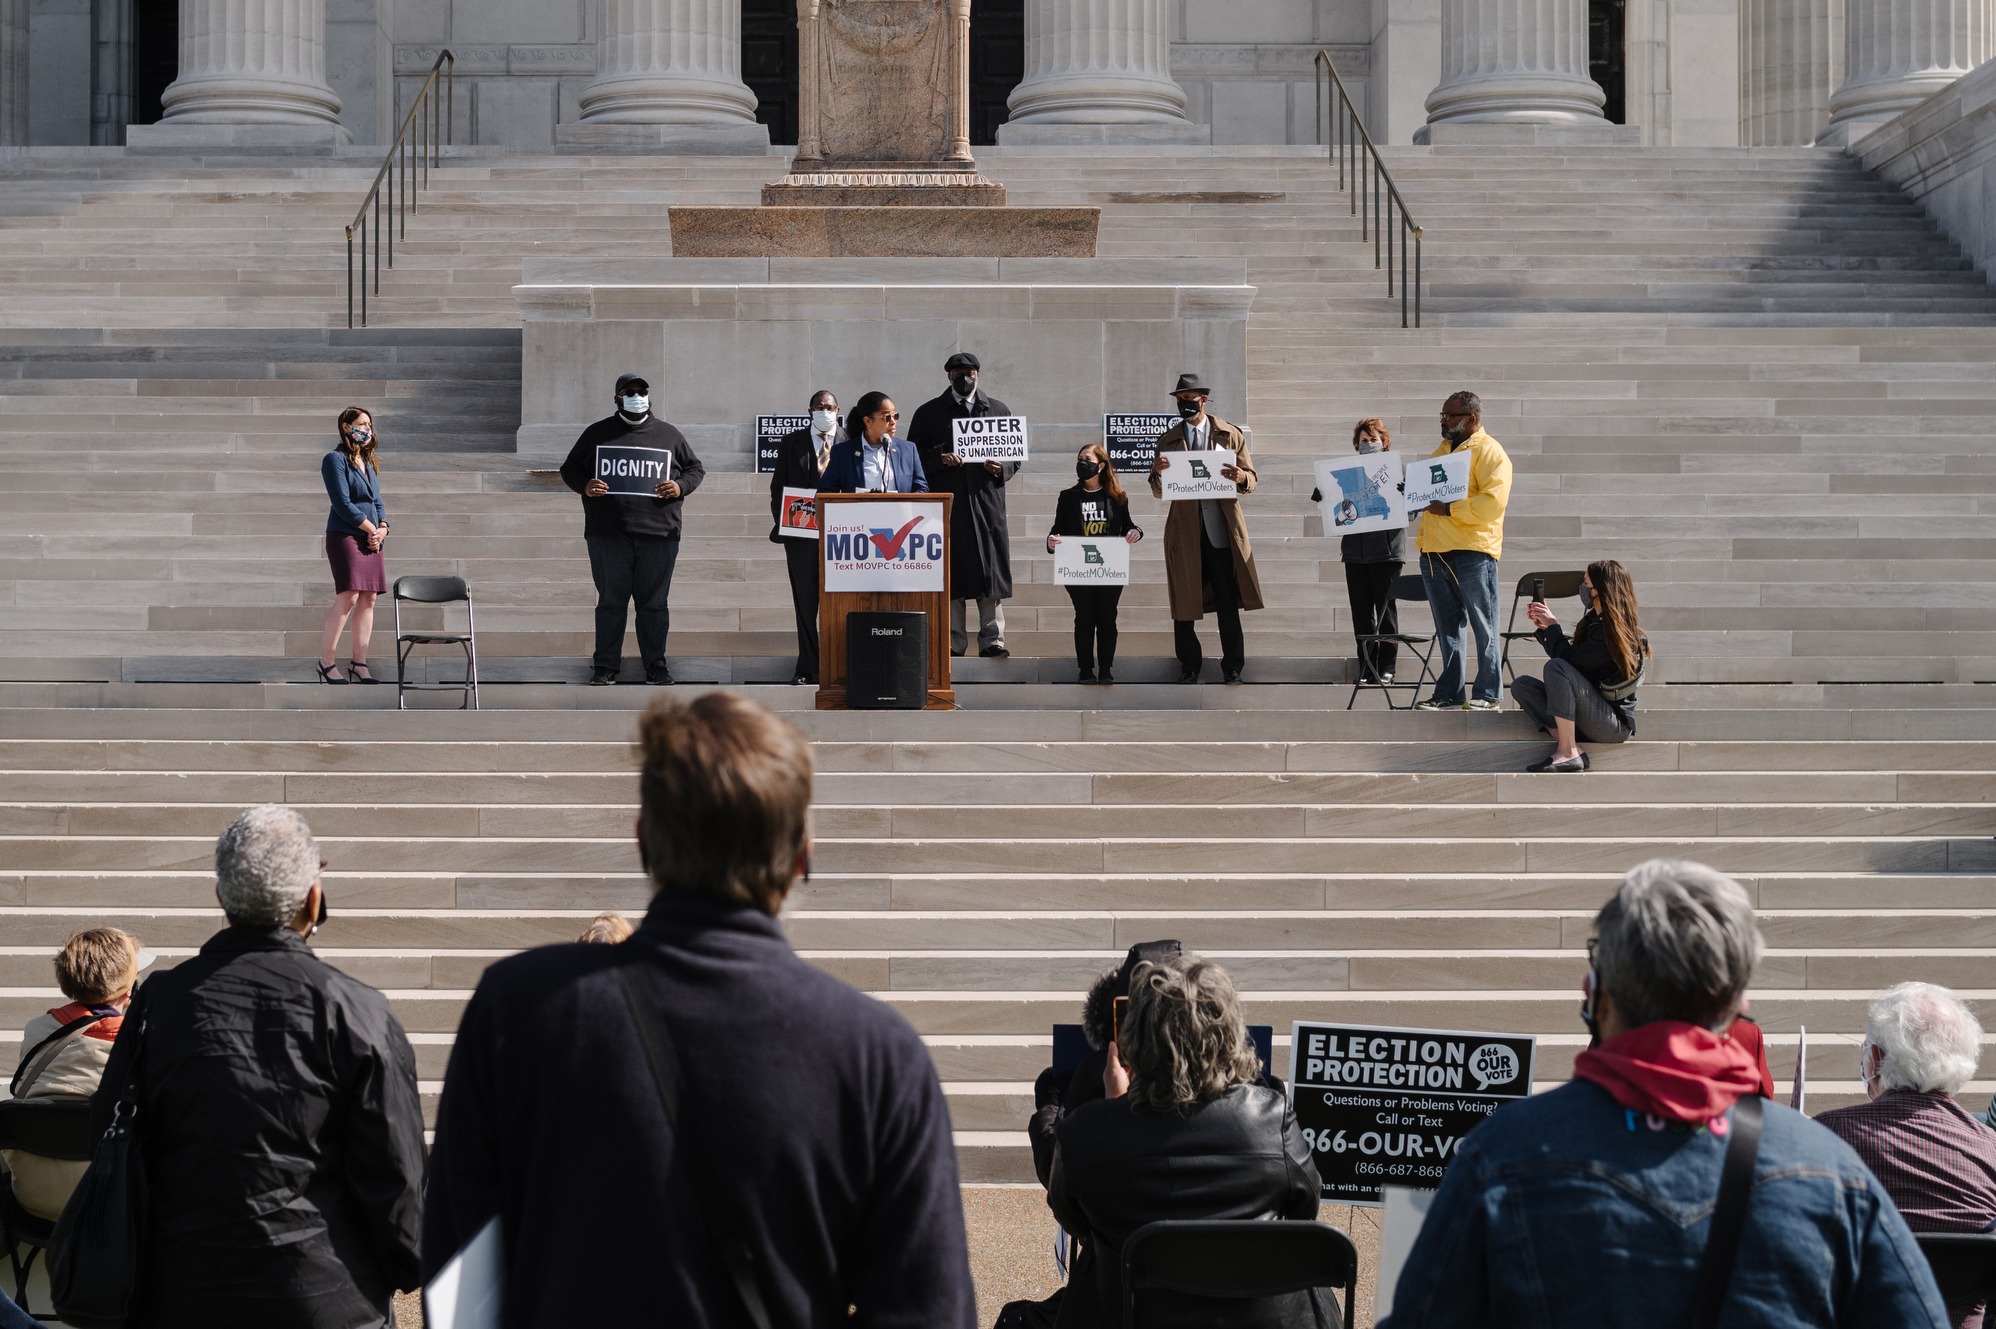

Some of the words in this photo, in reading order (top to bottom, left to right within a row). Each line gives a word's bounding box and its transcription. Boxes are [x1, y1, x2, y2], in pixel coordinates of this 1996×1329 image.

[957, 419, 1021, 434] VOTER
[1110, 417, 1167, 425] ELECTION
[1110, 426, 1167, 434] PROTECTION
[958, 435, 1023, 446] SUPPRESSION
[761, 450, 778, 458] 866
[958, 448, 966, 458] IS
[968, 447, 1024, 457] UNAMERICAN
[1110, 450, 1155, 459] 866-OUR
[601, 458, 664, 480] DIGNITY
[1167, 480, 1234, 493] #ProtectMOVoters
[1362, 472, 1390, 500] VOTE!
[1407, 484, 1466, 503] #ProtectMOVoters
[1058, 567, 1127, 579] #ProtectMOVoters
[872, 628, 903, 636] Roland
[1308, 1034, 1465, 1064] ELECTION
[1480, 1047, 1498, 1057] 866
[1476, 1056, 1511, 1071] OUR
[1306, 1058, 1464, 1088] PROTECTION
[1485, 1069, 1513, 1080] VOTE
[1323, 1092, 1381, 1108] Questions
[1384, 1098, 1397, 1108] or
[1401, 1097, 1454, 1111] Problems
[1457, 1100, 1498, 1117] Voting?
[1376, 1112, 1398, 1125] Call
[1402, 1116, 1415, 1126] or
[1417, 1114, 1443, 1127] Text
[1338, 1183, 1358, 1192] with
